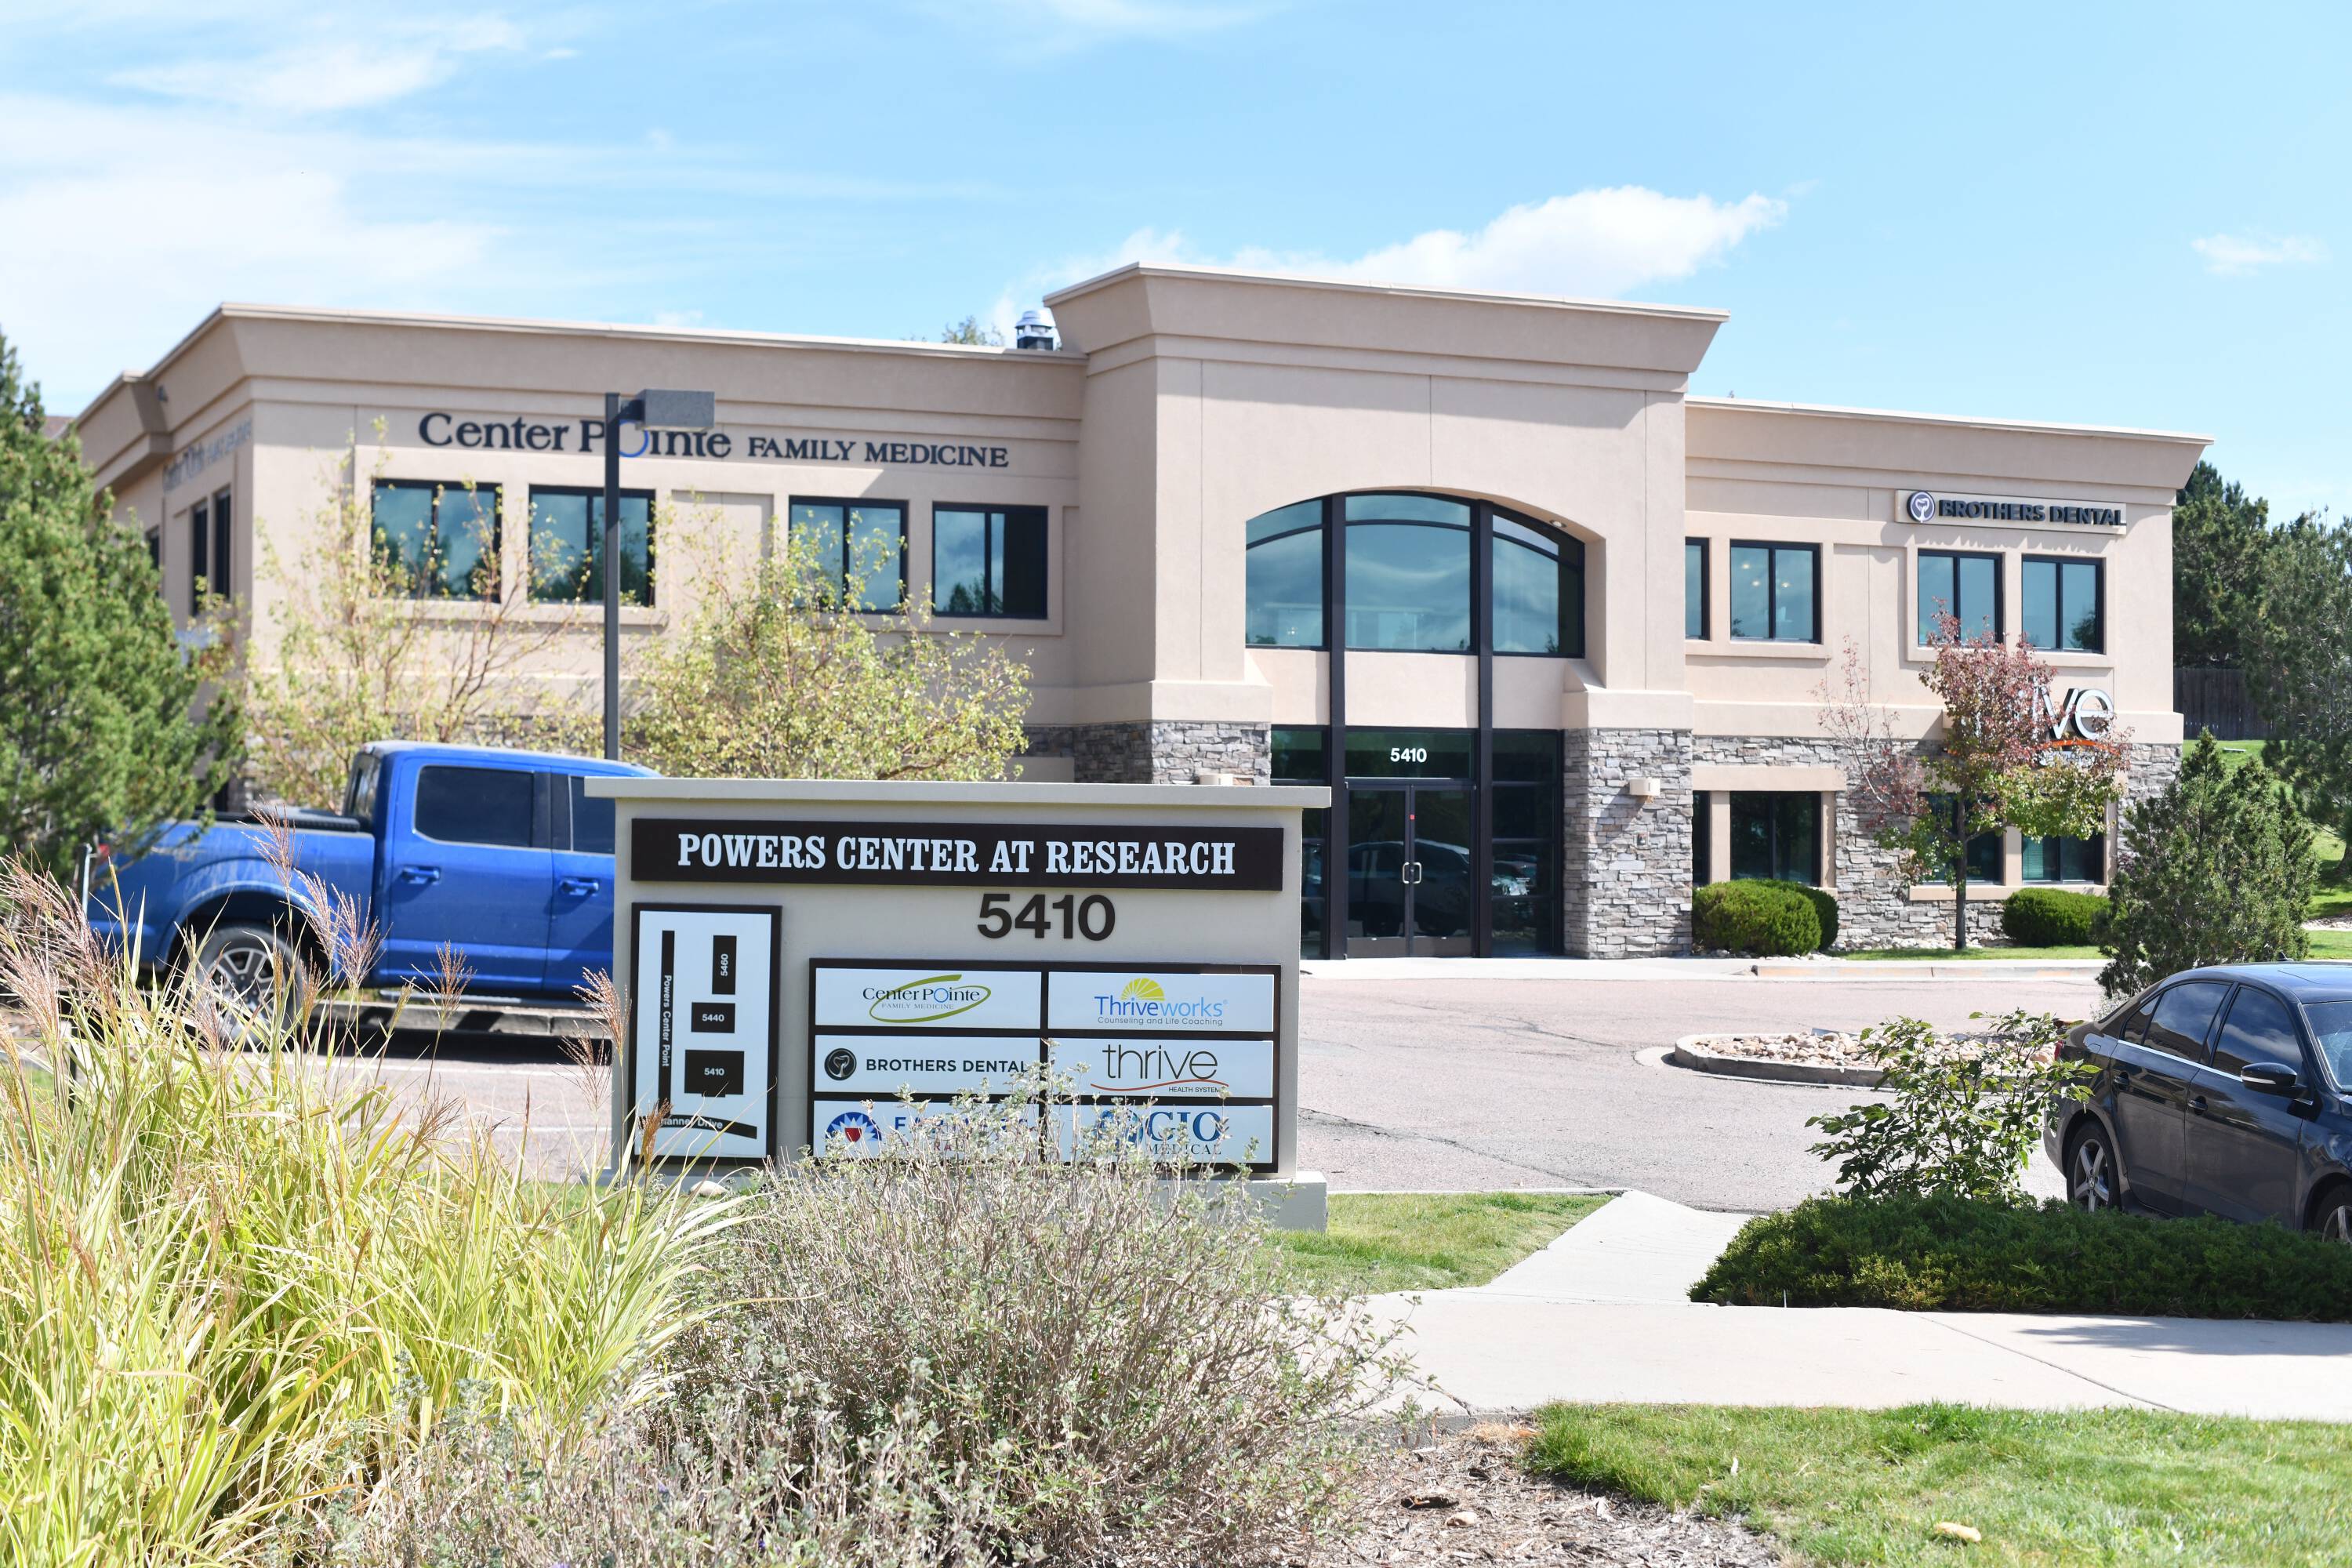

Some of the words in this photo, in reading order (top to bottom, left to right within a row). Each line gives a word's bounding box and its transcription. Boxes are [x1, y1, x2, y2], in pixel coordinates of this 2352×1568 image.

[419, 412, 570, 451] Center
[747, 437, 857, 461] FAMILY
[865, 441, 1009, 468] MEDICINE
[1938, 499, 2045, 522] BROTHERS
[2049, 506, 2126, 526] DENTAL
[1390, 747, 1427, 763] 5410
[677, 833, 826, 869] POWERS
[837, 837, 979, 873] CENTER
[989, 840, 1034, 873] AT
[1046, 840, 1236, 875] RESEARCH
[977, 893, 1116, 942] 5410
[720, 953, 728, 977] 5460
[663, 975, 672, 1008] Powers
[862, 987, 919, 1000] Center
[662, 1011, 672, 1042] Center
[702, 1014, 724, 1022] 5440
[1098, 1017, 1144, 1025] Counseling
[1182, 1018, 1223, 1026] Coaching
[662, 1044, 670, 1067] Point
[866, 1058, 956, 1073] BROTHERS
[962, 1060, 1029, 1073] DENTAL
[1102, 1044, 1218, 1080] thrive
